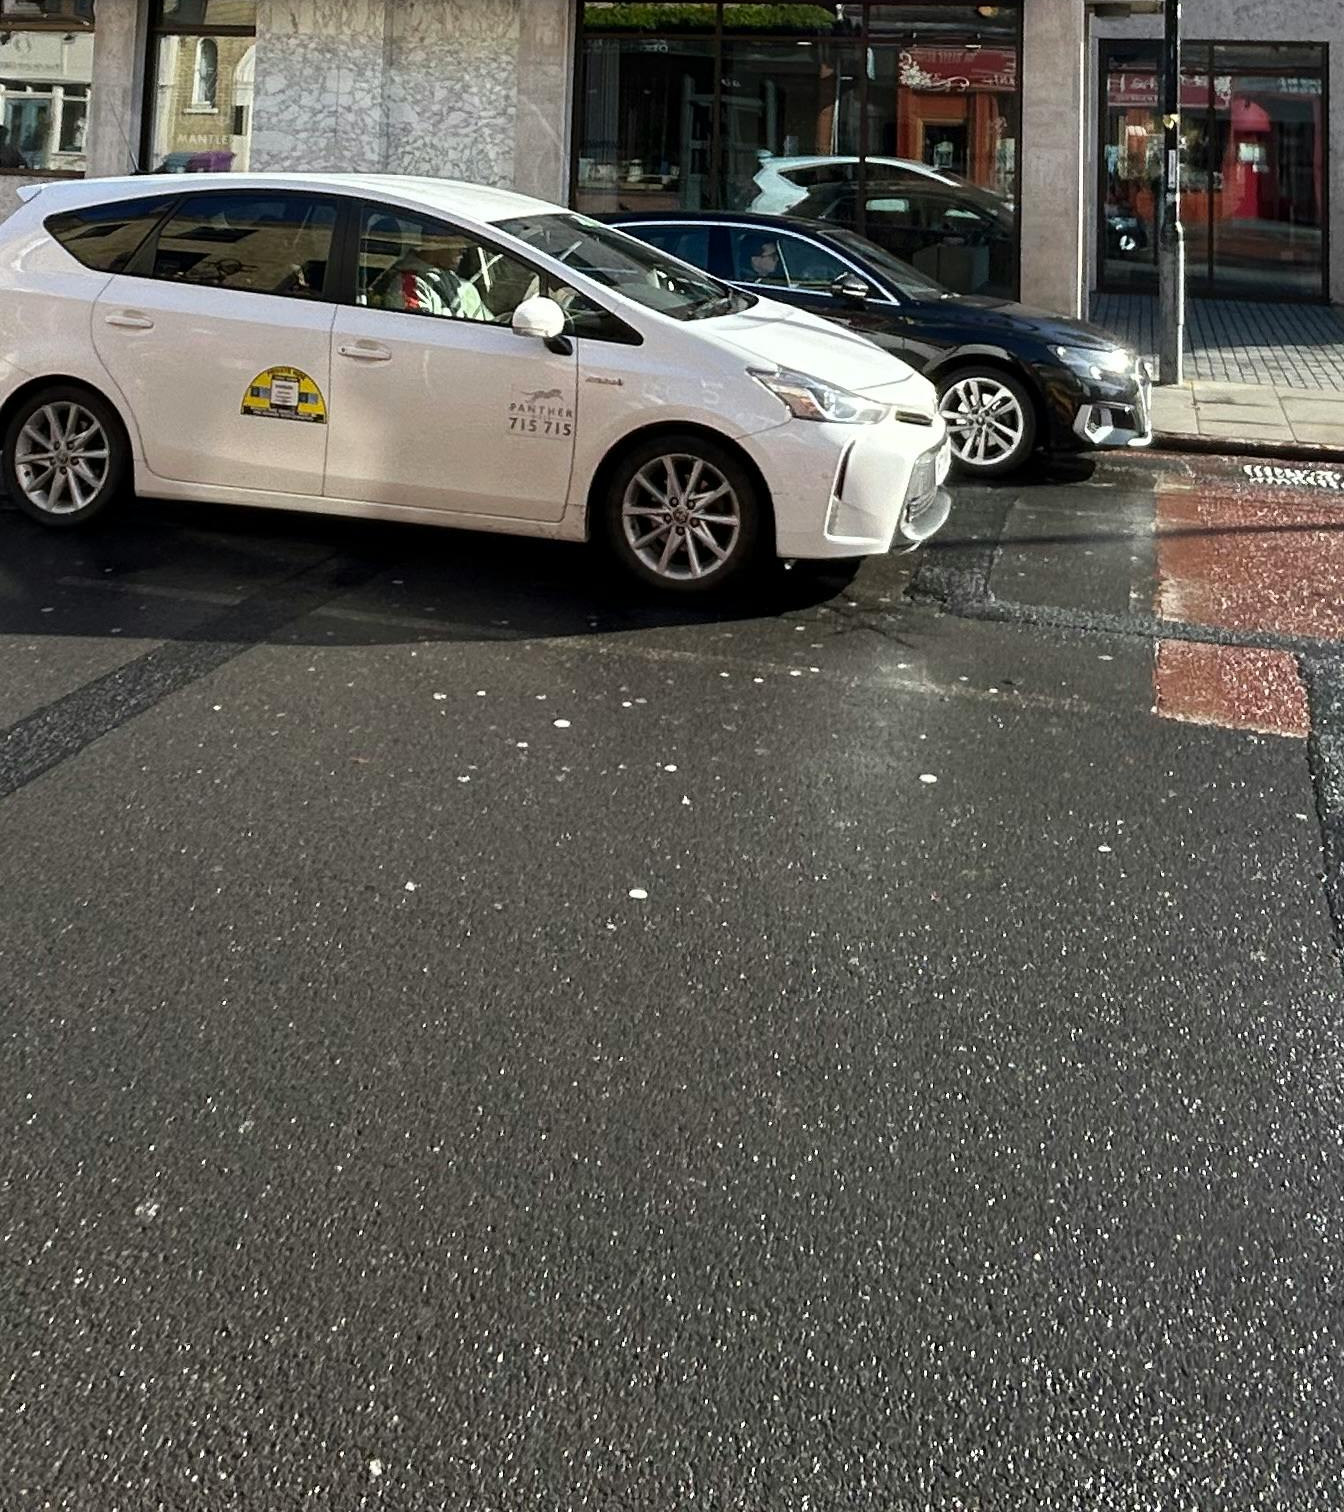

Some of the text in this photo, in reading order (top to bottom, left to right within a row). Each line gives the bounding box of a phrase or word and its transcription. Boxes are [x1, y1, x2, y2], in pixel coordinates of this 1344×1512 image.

[509, 403, 573, 418] PANTHER
[509, 417, 572, 436] 715 715
